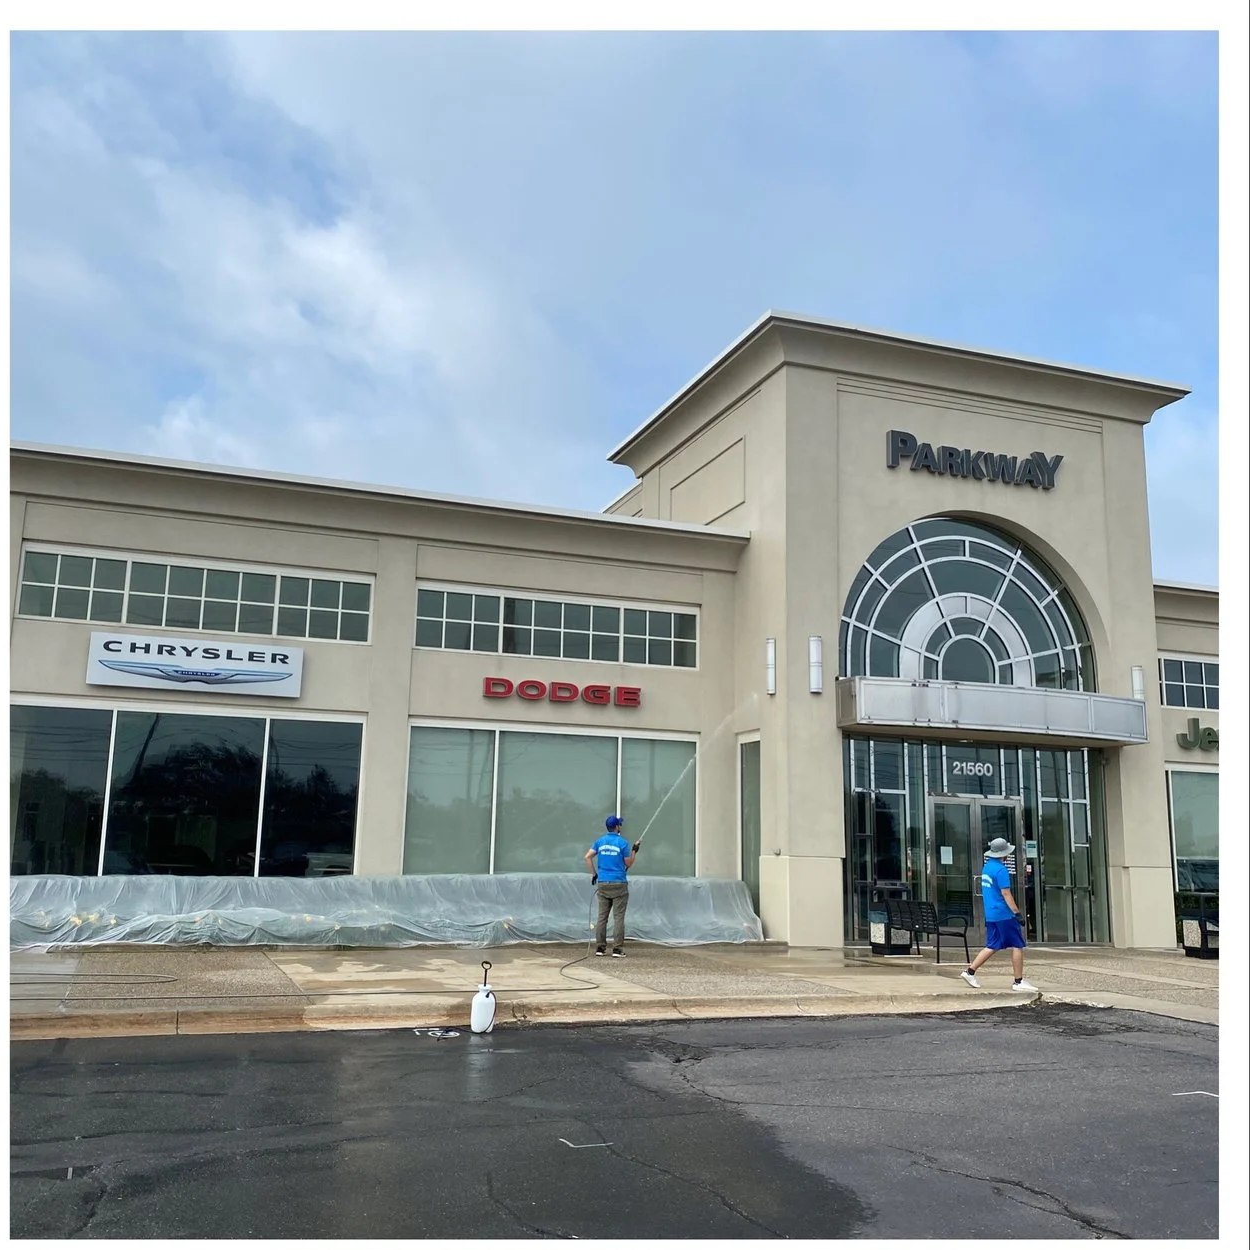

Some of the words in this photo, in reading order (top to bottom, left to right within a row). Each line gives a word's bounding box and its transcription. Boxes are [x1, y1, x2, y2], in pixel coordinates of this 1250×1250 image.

[886, 430, 1065, 489] PARKWAY
[102, 640, 290, 664] CHRYSLER
[483, 677, 641, 707] DODGE
[952, 761, 993, 776] 21560
